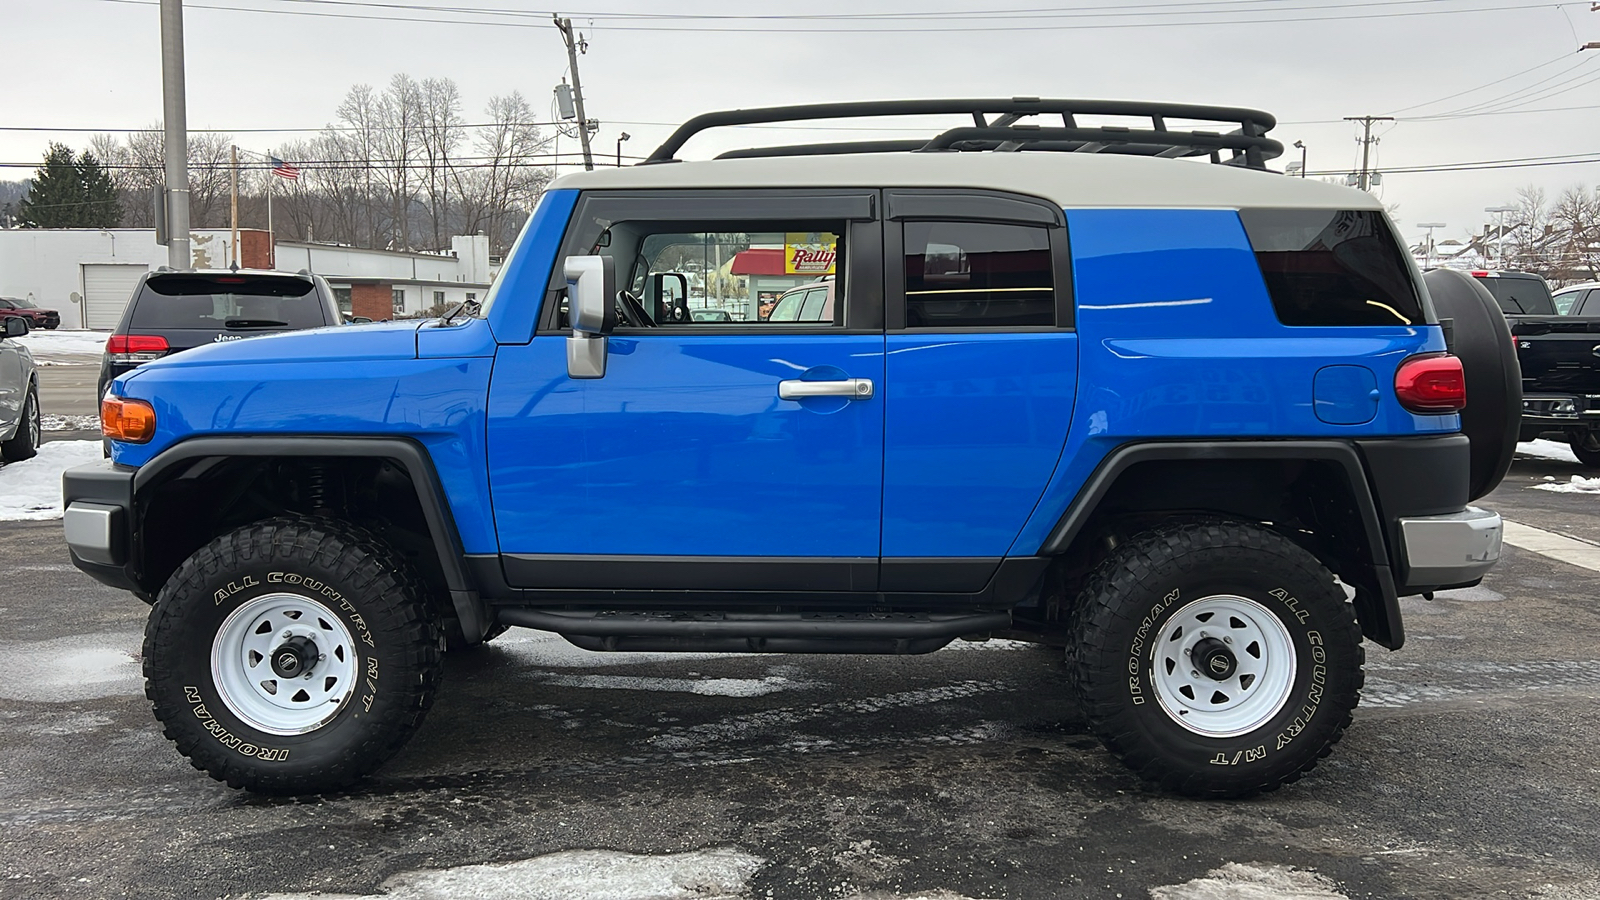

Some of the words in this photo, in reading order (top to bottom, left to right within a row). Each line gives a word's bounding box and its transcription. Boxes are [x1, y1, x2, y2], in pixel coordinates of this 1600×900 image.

[213, 576, 260, 605] ALL
[267, 572, 375, 648] COUNTRY
[361, 657, 379, 712] M/T
[1128, 588, 1180, 705] IRONMAN
[1268, 588, 1310, 624] ALL
[184, 686, 289, 761] IRONMAN
[1276, 630, 1326, 750] COUNTRY
[1210, 745, 1267, 765] M/T
